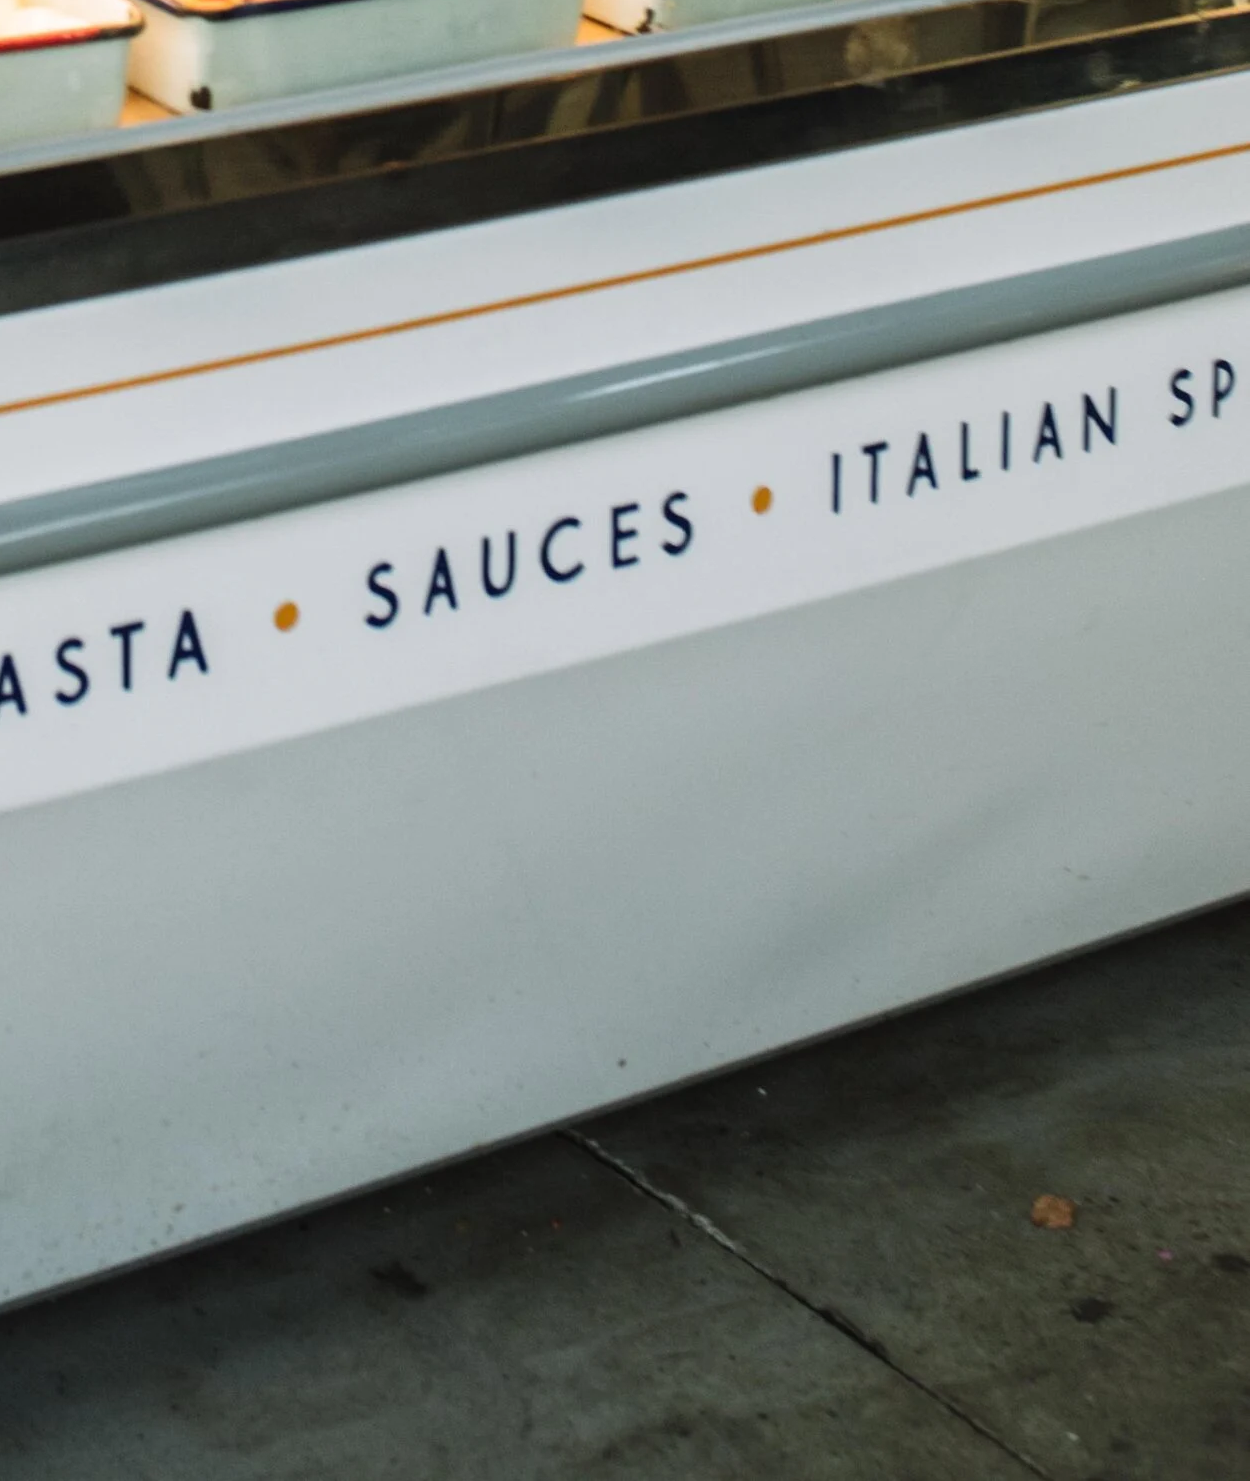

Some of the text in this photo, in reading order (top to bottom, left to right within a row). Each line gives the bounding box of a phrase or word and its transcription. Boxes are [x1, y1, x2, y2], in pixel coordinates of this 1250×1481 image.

[364, 490, 696, 629] SAUCES
[828, 385, 1119, 514] ITALIAN
[1167, 357, 1237, 428] SP
